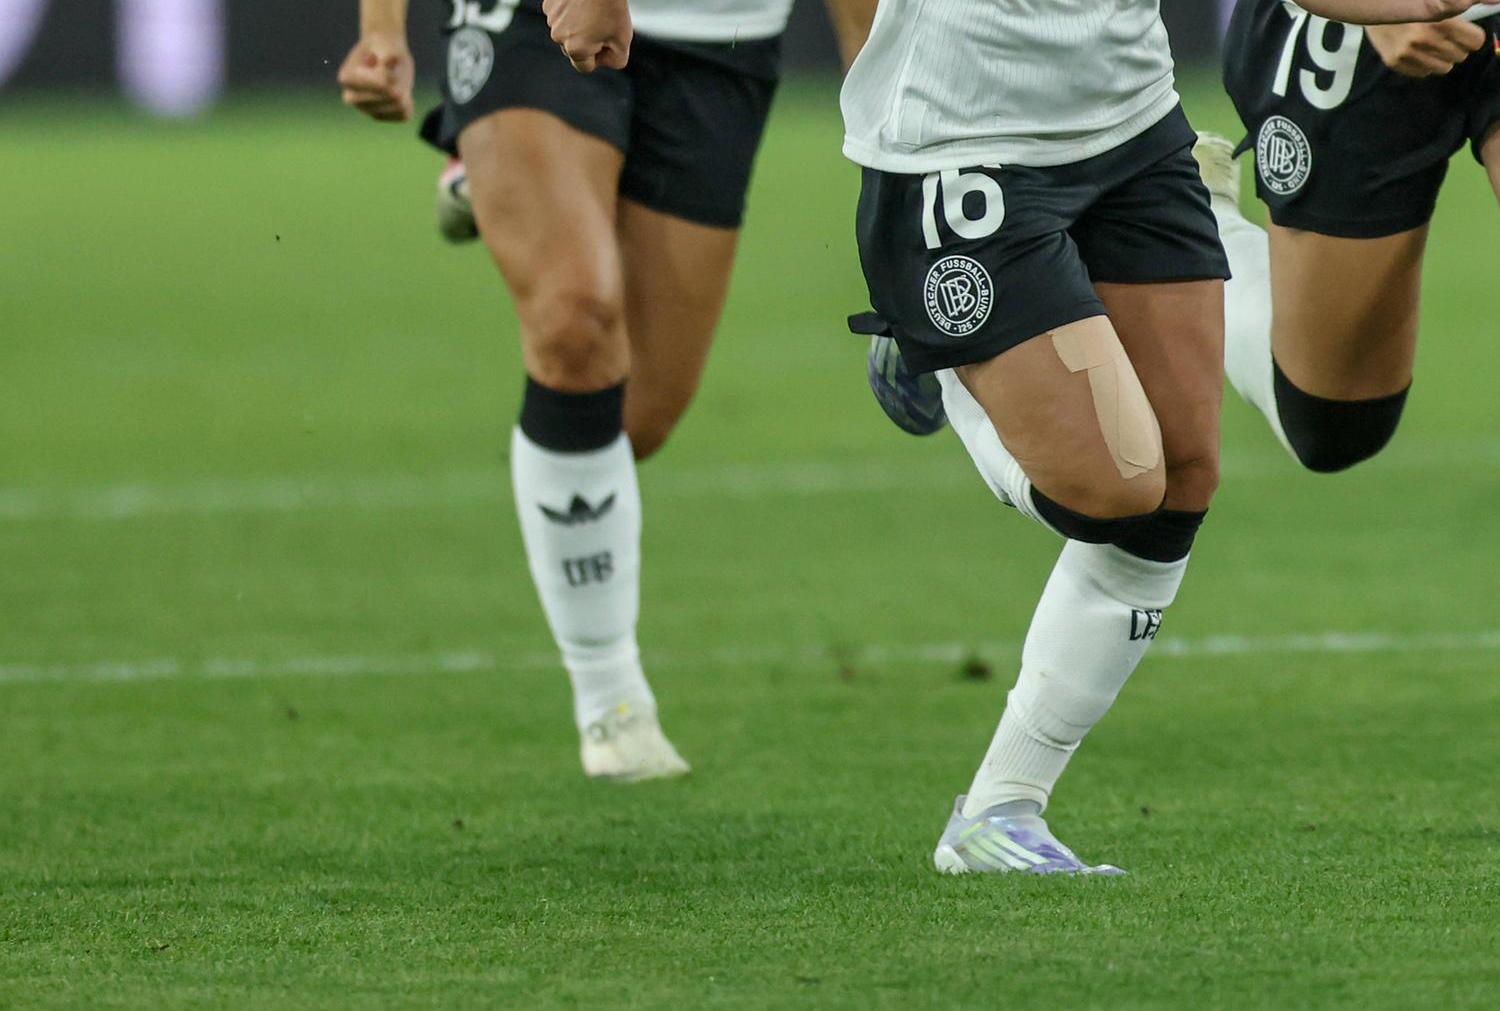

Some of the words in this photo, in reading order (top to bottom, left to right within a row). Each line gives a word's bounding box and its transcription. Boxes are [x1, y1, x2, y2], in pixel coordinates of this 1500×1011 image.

[1272, 2, 1364, 110] 19
[922, 163, 1005, 250] 16
[927, 271, 952, 331] DEUTSCHER
[957, 320, 974, 333] 125
